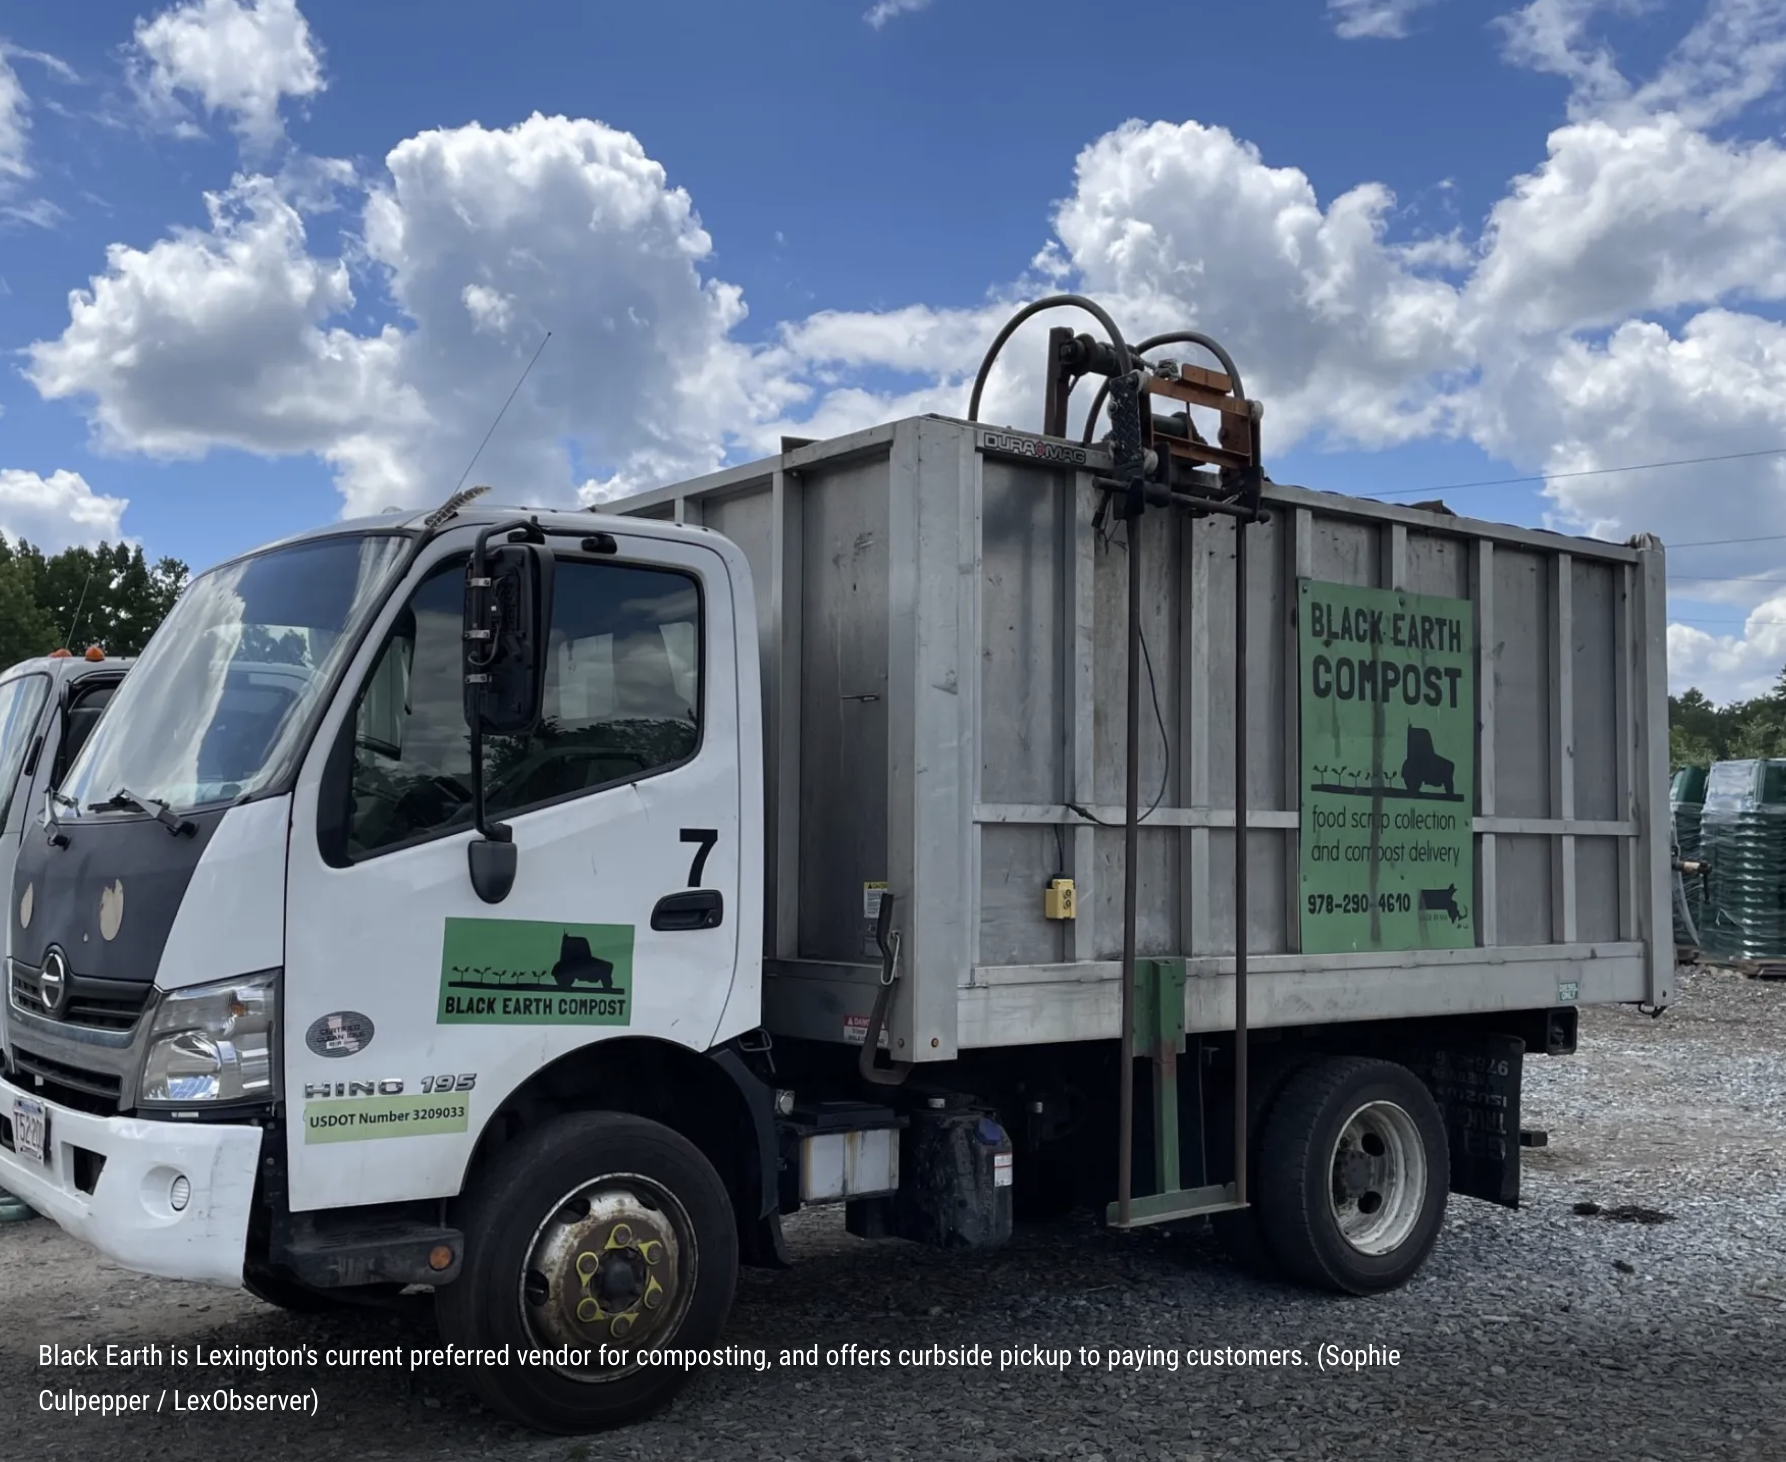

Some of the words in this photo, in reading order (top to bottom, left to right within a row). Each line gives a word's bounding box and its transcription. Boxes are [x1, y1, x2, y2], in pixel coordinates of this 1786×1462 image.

[1311, 602, 1384, 644] BLACK
[1392, 613, 1462, 653] EARTH
[1312, 655, 1462, 708] COMPOST
[1312, 804, 1346, 834] food
[1351, 812, 1390, 834] scrp
[1395, 807, 1456, 830] collection
[679, 828, 718, 887] 7
[1311, 838, 1340, 862] and
[1409, 839, 1460, 868] delivery
[1308, 893, 1411, 914] 978-290-4610
[445, 996, 496, 1014] BLACK
[503, 997, 553, 1015] EARTH
[558, 999, 626, 1016] COMPOST
[854, 1017, 871, 1027] DANG
[304, 1078, 405, 1098] HINO
[420, 1073, 477, 1094] 195
[310, 1114, 356, 1128] USDOT
[359, 1109, 410, 1124] Number
[412, 1107, 465, 1121] 3209033
